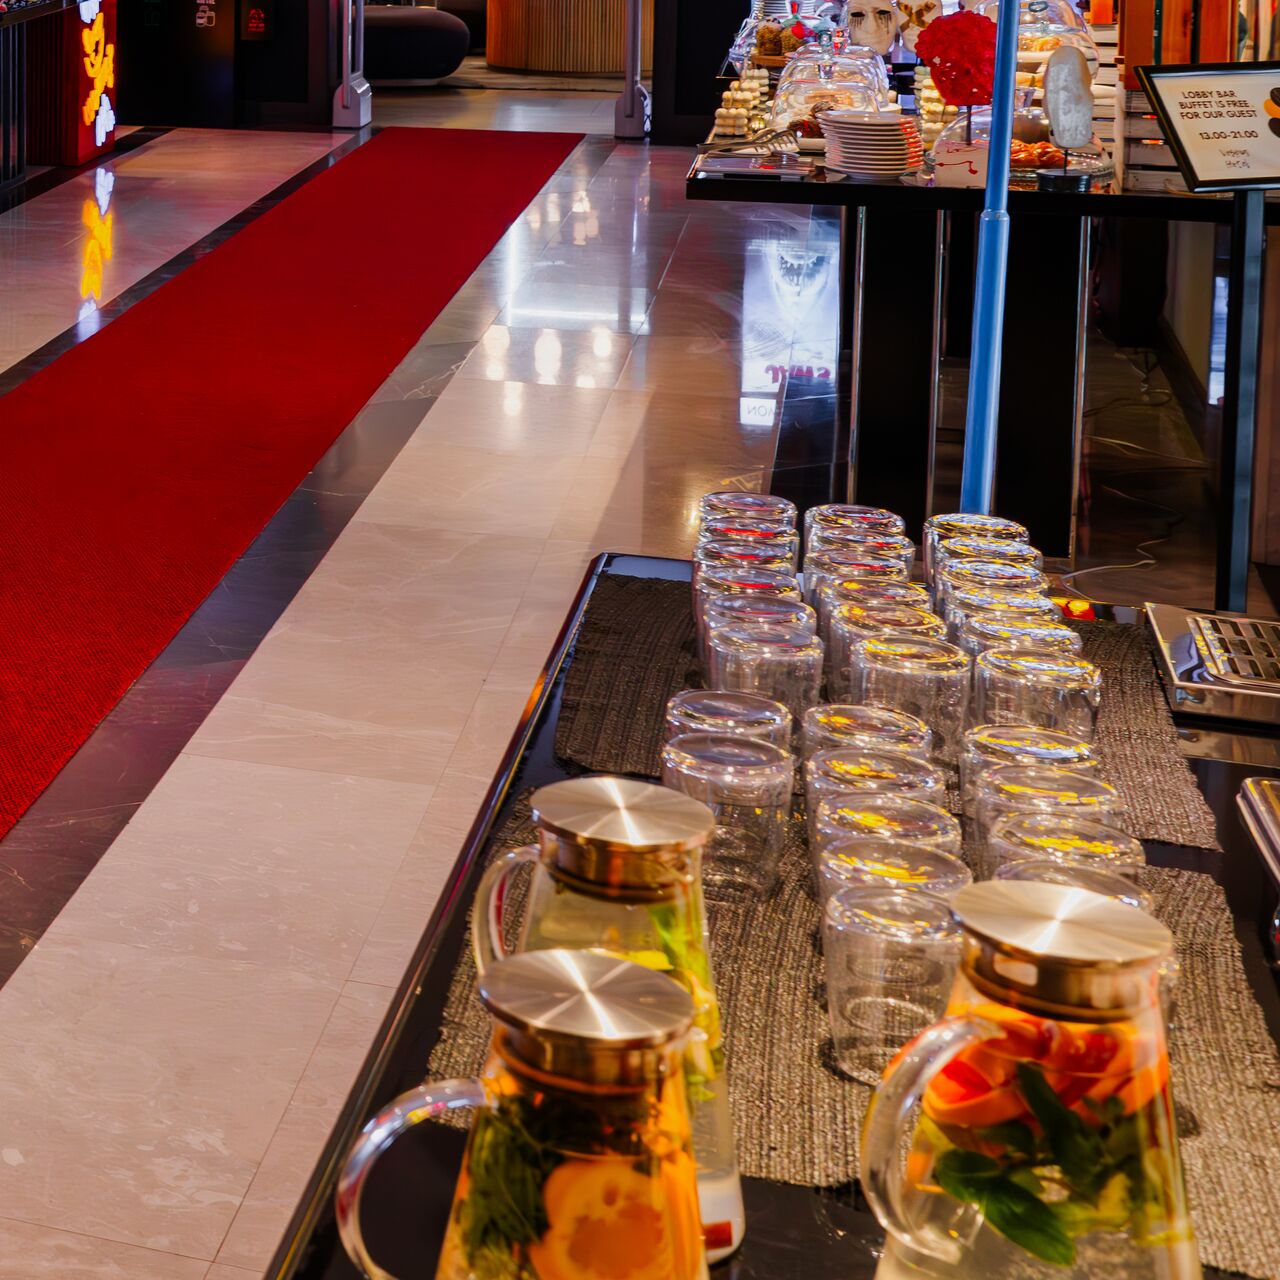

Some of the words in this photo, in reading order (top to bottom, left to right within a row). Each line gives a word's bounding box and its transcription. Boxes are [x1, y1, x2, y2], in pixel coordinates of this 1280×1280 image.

[1181, 90, 1214, 99] LOBBY
[1216, 90, 1238, 98] BAR
[1178, 101, 1213, 110] BUFFET
[1215, 101, 1226, 109] IS
[1227, 100, 1250, 108] FREE
[1180, 111, 1202, 120] FOR
[1203, 110, 1225, 119] OUR
[1226, 109, 1258, 118] GUEST
[1199, 130, 1259, 140] 13.00-21.00
